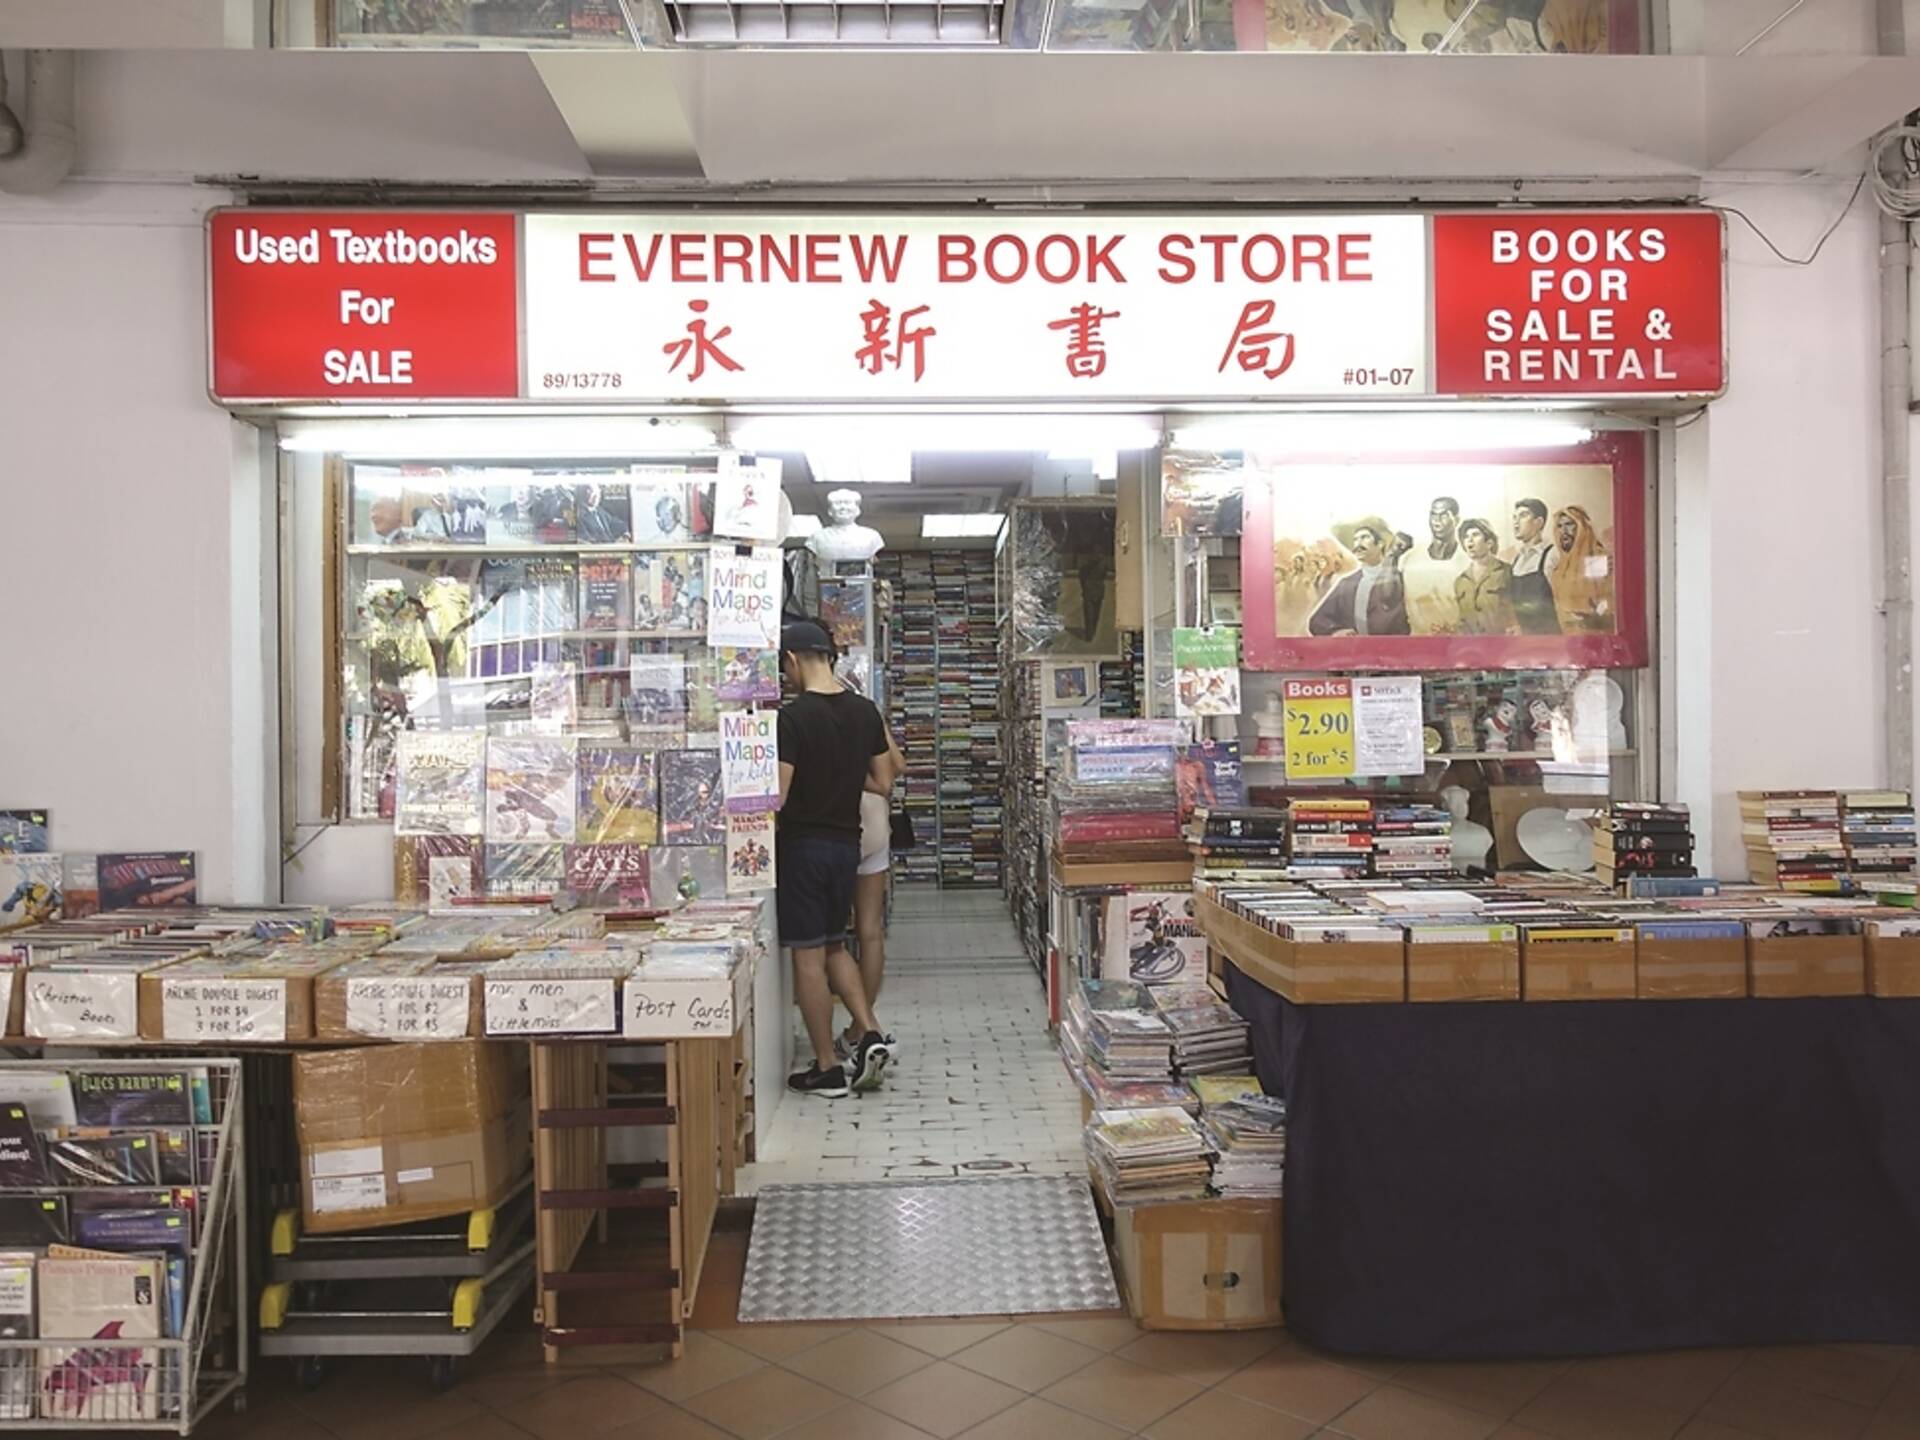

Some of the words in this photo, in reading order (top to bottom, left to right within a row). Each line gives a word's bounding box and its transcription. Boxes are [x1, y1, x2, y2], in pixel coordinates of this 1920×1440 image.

[235, 229, 319, 264] Used
[330, 229, 497, 264] Textbooks
[578, 234, 908, 283] EVERNEW
[938, 234, 1127, 283] BOOK
[1157, 234, 1373, 283] STORE
[1491, 229, 1667, 264] BOOKS
[1531, 269, 1629, 303] FOR
[341, 290, 395, 326] For
[1486, 309, 1615, 342] SALE
[1644, 308, 1673, 342] &
[324, 350, 413, 385] SALE
[1343, 367, 1415, 387] #01-07
[1483, 349, 1678, 382] RENTAL
[543, 372, 622, 391] 89/13778
[714, 567, 767, 589] Mind
[712, 589, 774, 613] Maps
[1288, 682, 1348, 696] Books
[725, 717, 769, 737] Mind
[1287, 708, 1349, 735] $2.90
[726, 741, 775, 764] Maps
[1292, 752, 1300, 766] 2
[1306, 750, 1328, 766] for
[574, 856, 640, 873] CATS
[1164, 925, 1206, 938] MANG
